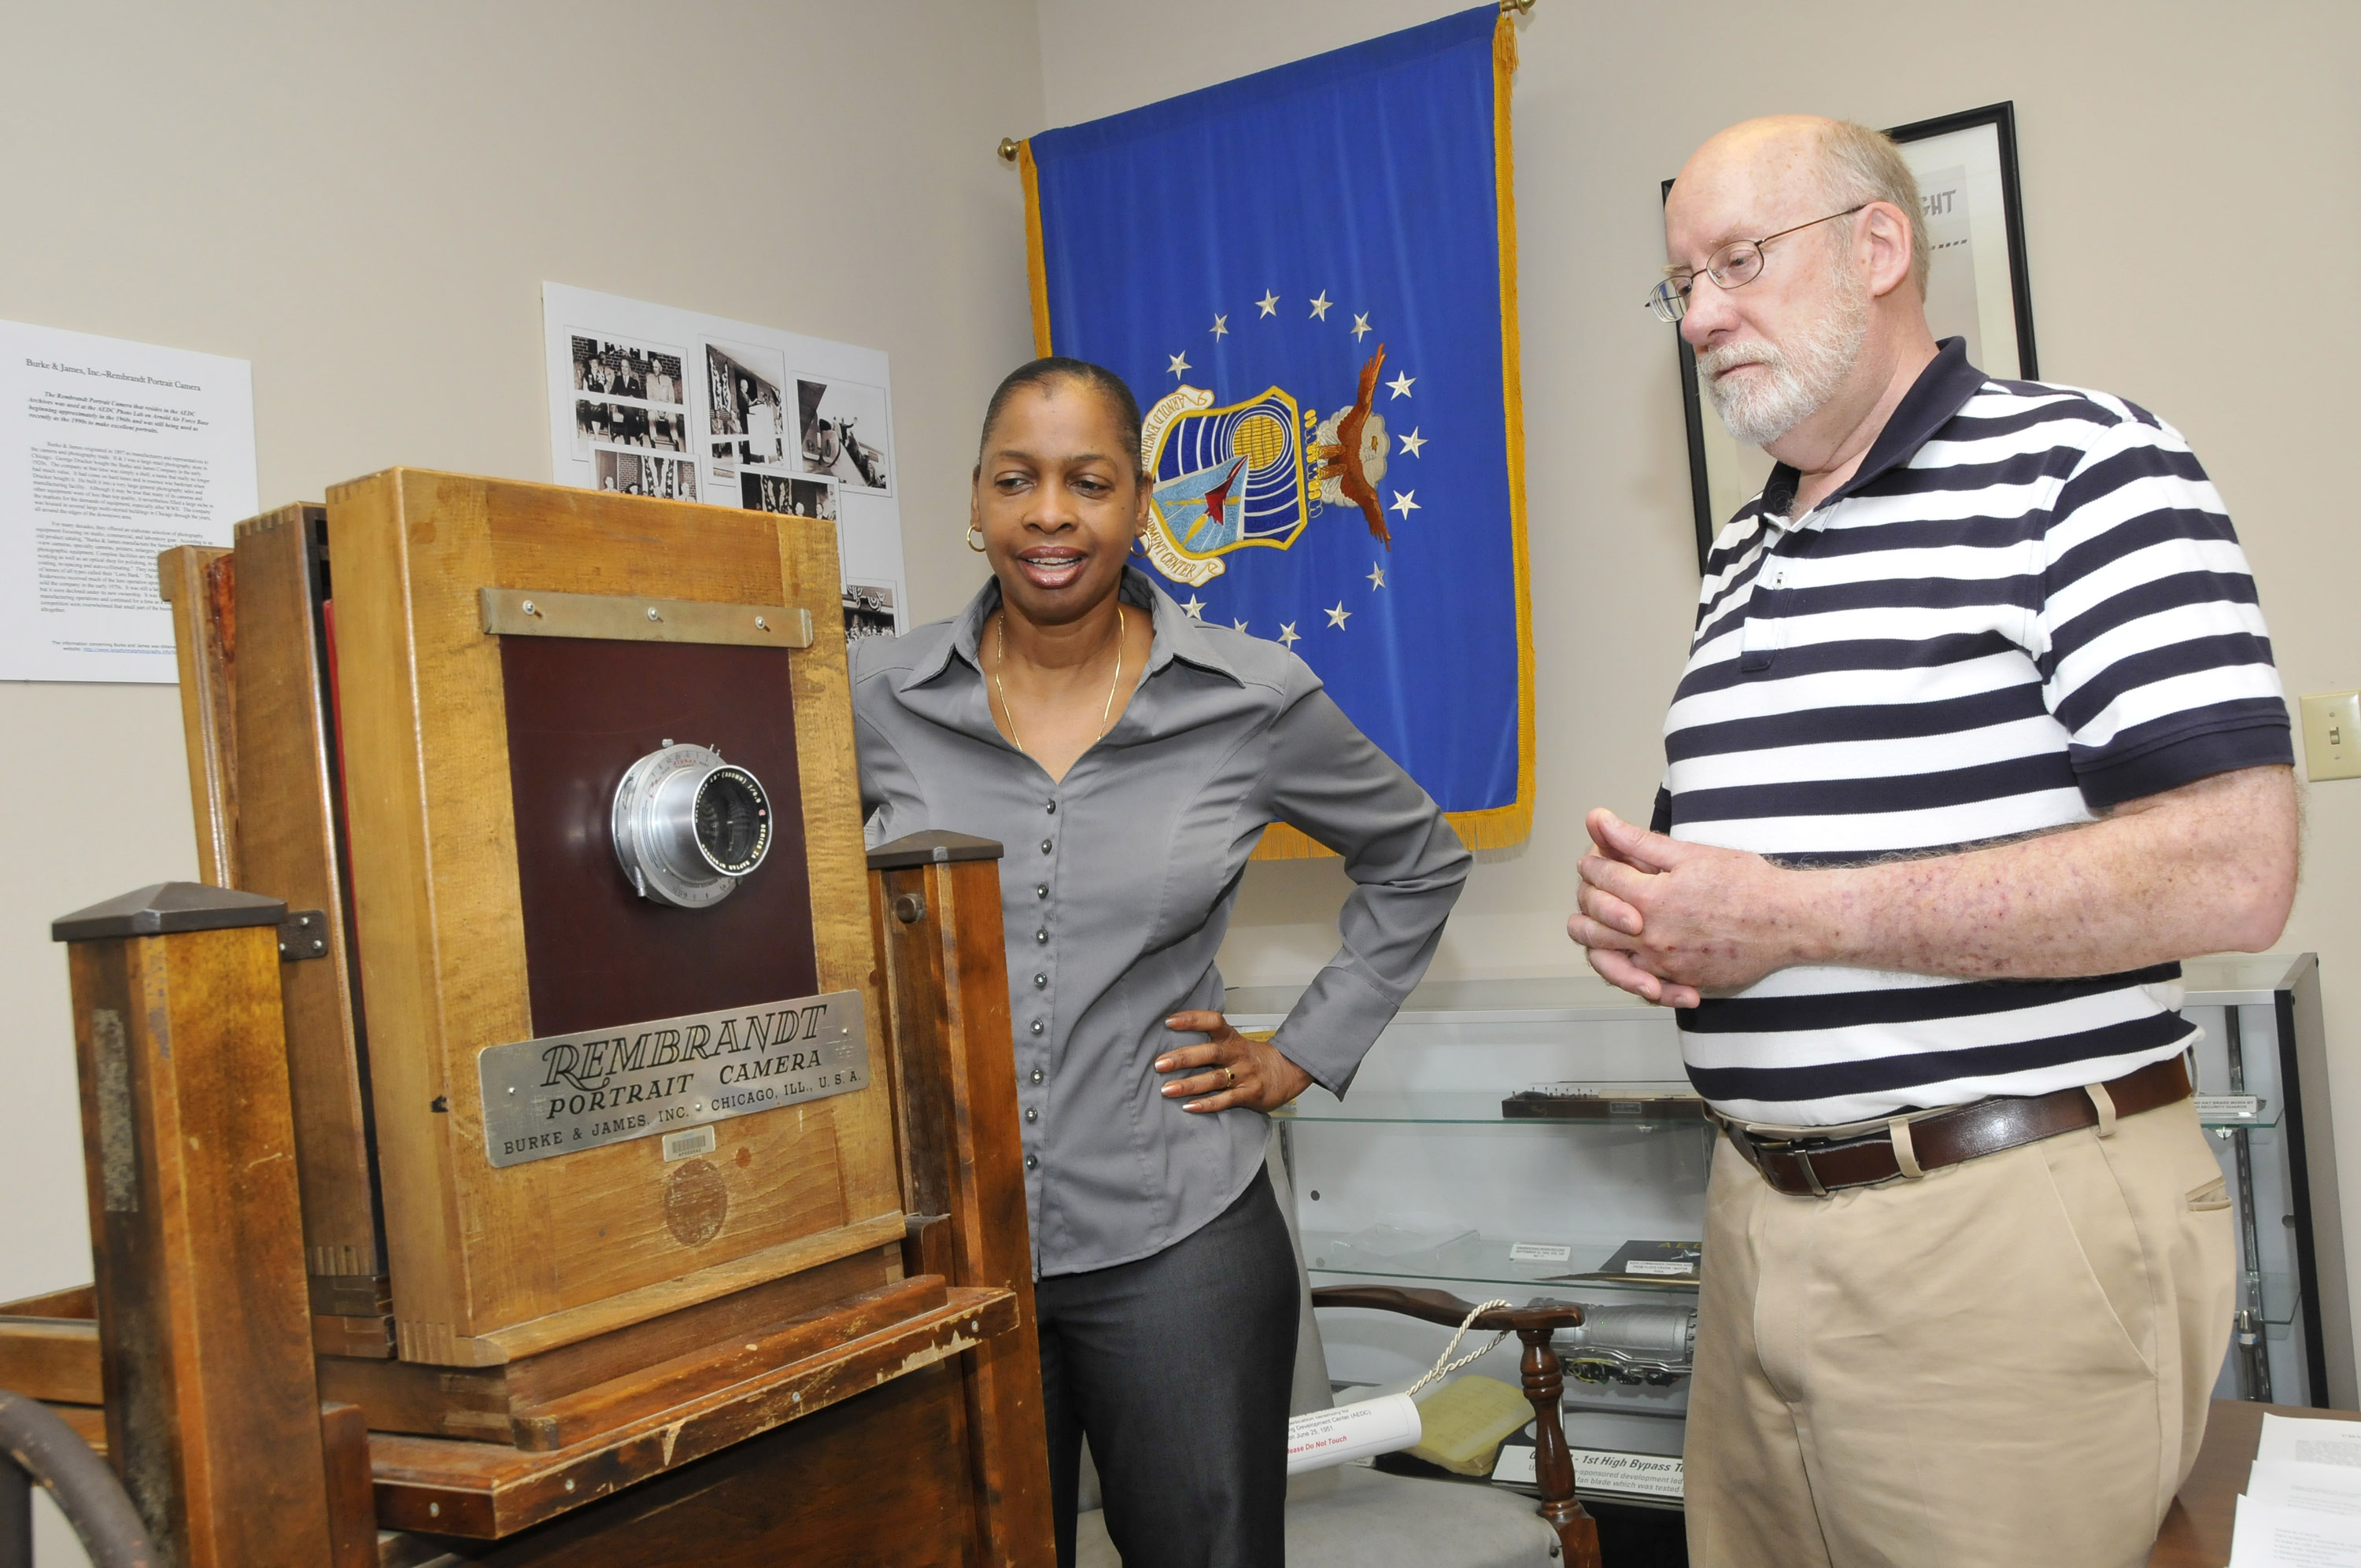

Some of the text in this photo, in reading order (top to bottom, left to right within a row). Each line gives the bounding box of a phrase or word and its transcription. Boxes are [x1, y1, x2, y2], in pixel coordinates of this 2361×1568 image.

[1920, 189, 1957, 217] GHT
[26, 359, 50, 369] Burke
[60, 363, 86, 374] James,
[147, 377, 173, 387] Portrait
[175, 381, 201, 391] Camera
[1142, 395, 1197, 578] ARNOLD ENGINE OPMENT CENTER
[541, 1004, 827, 1092] REMBRANDT
[547, 1050, 822, 1120] PORTRAIT CAMERA
[504, 1131, 563, 1155] BURKE
[573, 1127, 582, 1141] &
[592, 1116, 650, 1138] JAMES,
[658, 1106, 689, 1123] INC.
[711, 1088, 779, 1111] CHICAGO,
[1295, 1419, 1332, 1431] Development
[1350, 1410, 1372, 1419] (AEDC)
[1288, 1445, 1304, 1454] lease
[1328, 1435, 1347, 1444] Touch
[1583, 1455, 1599, 1465] 1st
[1600, 1456, 1628, 1468] High
[1629, 1459, 1671, 1471] Bypass
[1591, 1478, 1611, 1486] blade
[1613, 1480, 1635, 1489] which
[1620, 1473, 1668, 1483] development
